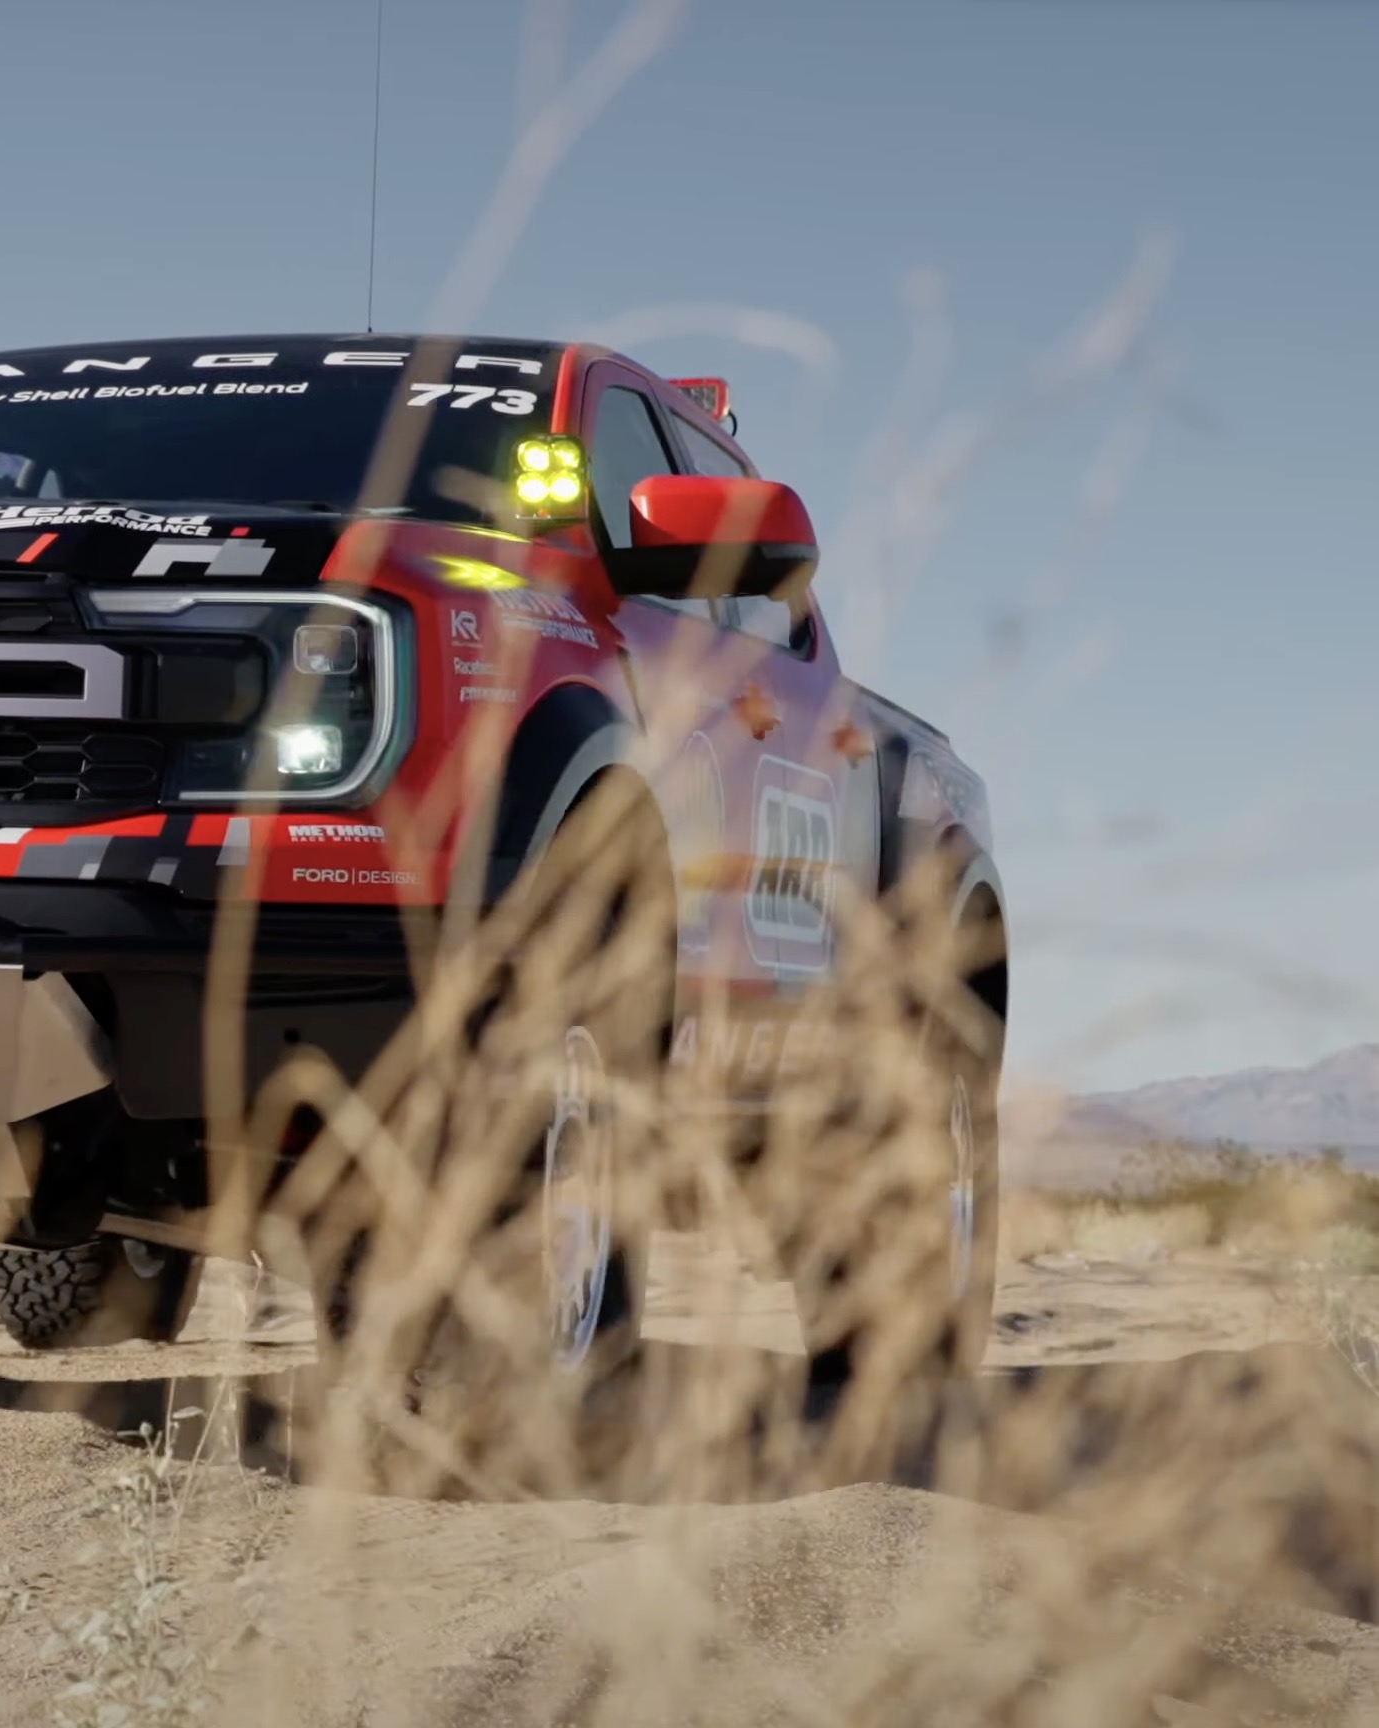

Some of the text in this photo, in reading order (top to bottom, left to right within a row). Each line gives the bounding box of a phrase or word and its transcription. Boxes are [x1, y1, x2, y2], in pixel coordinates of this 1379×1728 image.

[9, 388, 89, 403] Shell
[93, 383, 208, 399] Biofuel
[213, 382, 310, 395] Blend
[406, 383, 538, 415] 773
[34, 514, 213, 537] PERFORMANCE
[288, 825, 385, 838] METHOD
[292, 867, 419, 885] FORD DESIGN
